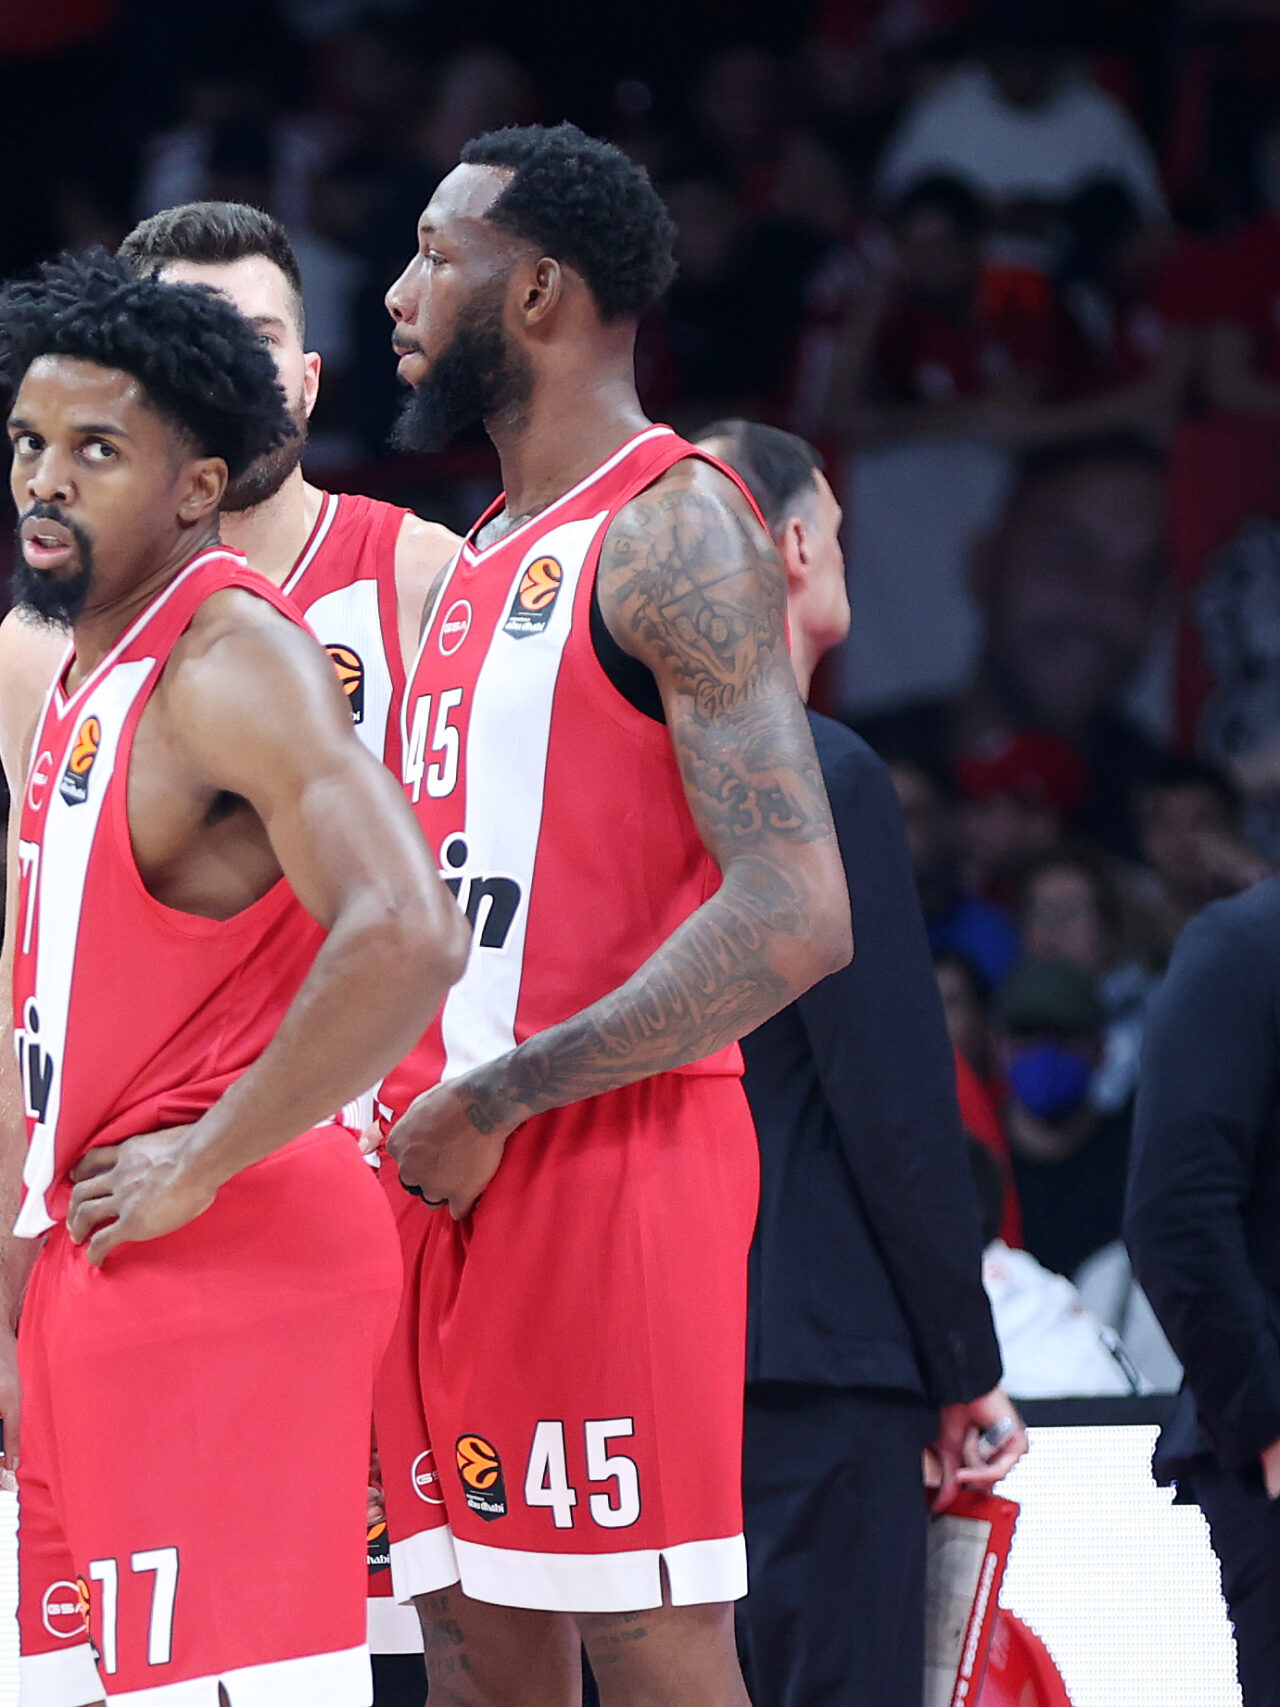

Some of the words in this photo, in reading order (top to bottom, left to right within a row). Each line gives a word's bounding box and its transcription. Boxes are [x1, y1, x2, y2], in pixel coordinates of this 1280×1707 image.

[404, 687, 463, 804] 45
[444, 838, 522, 950] in
[524, 1416, 641, 1529] 45
